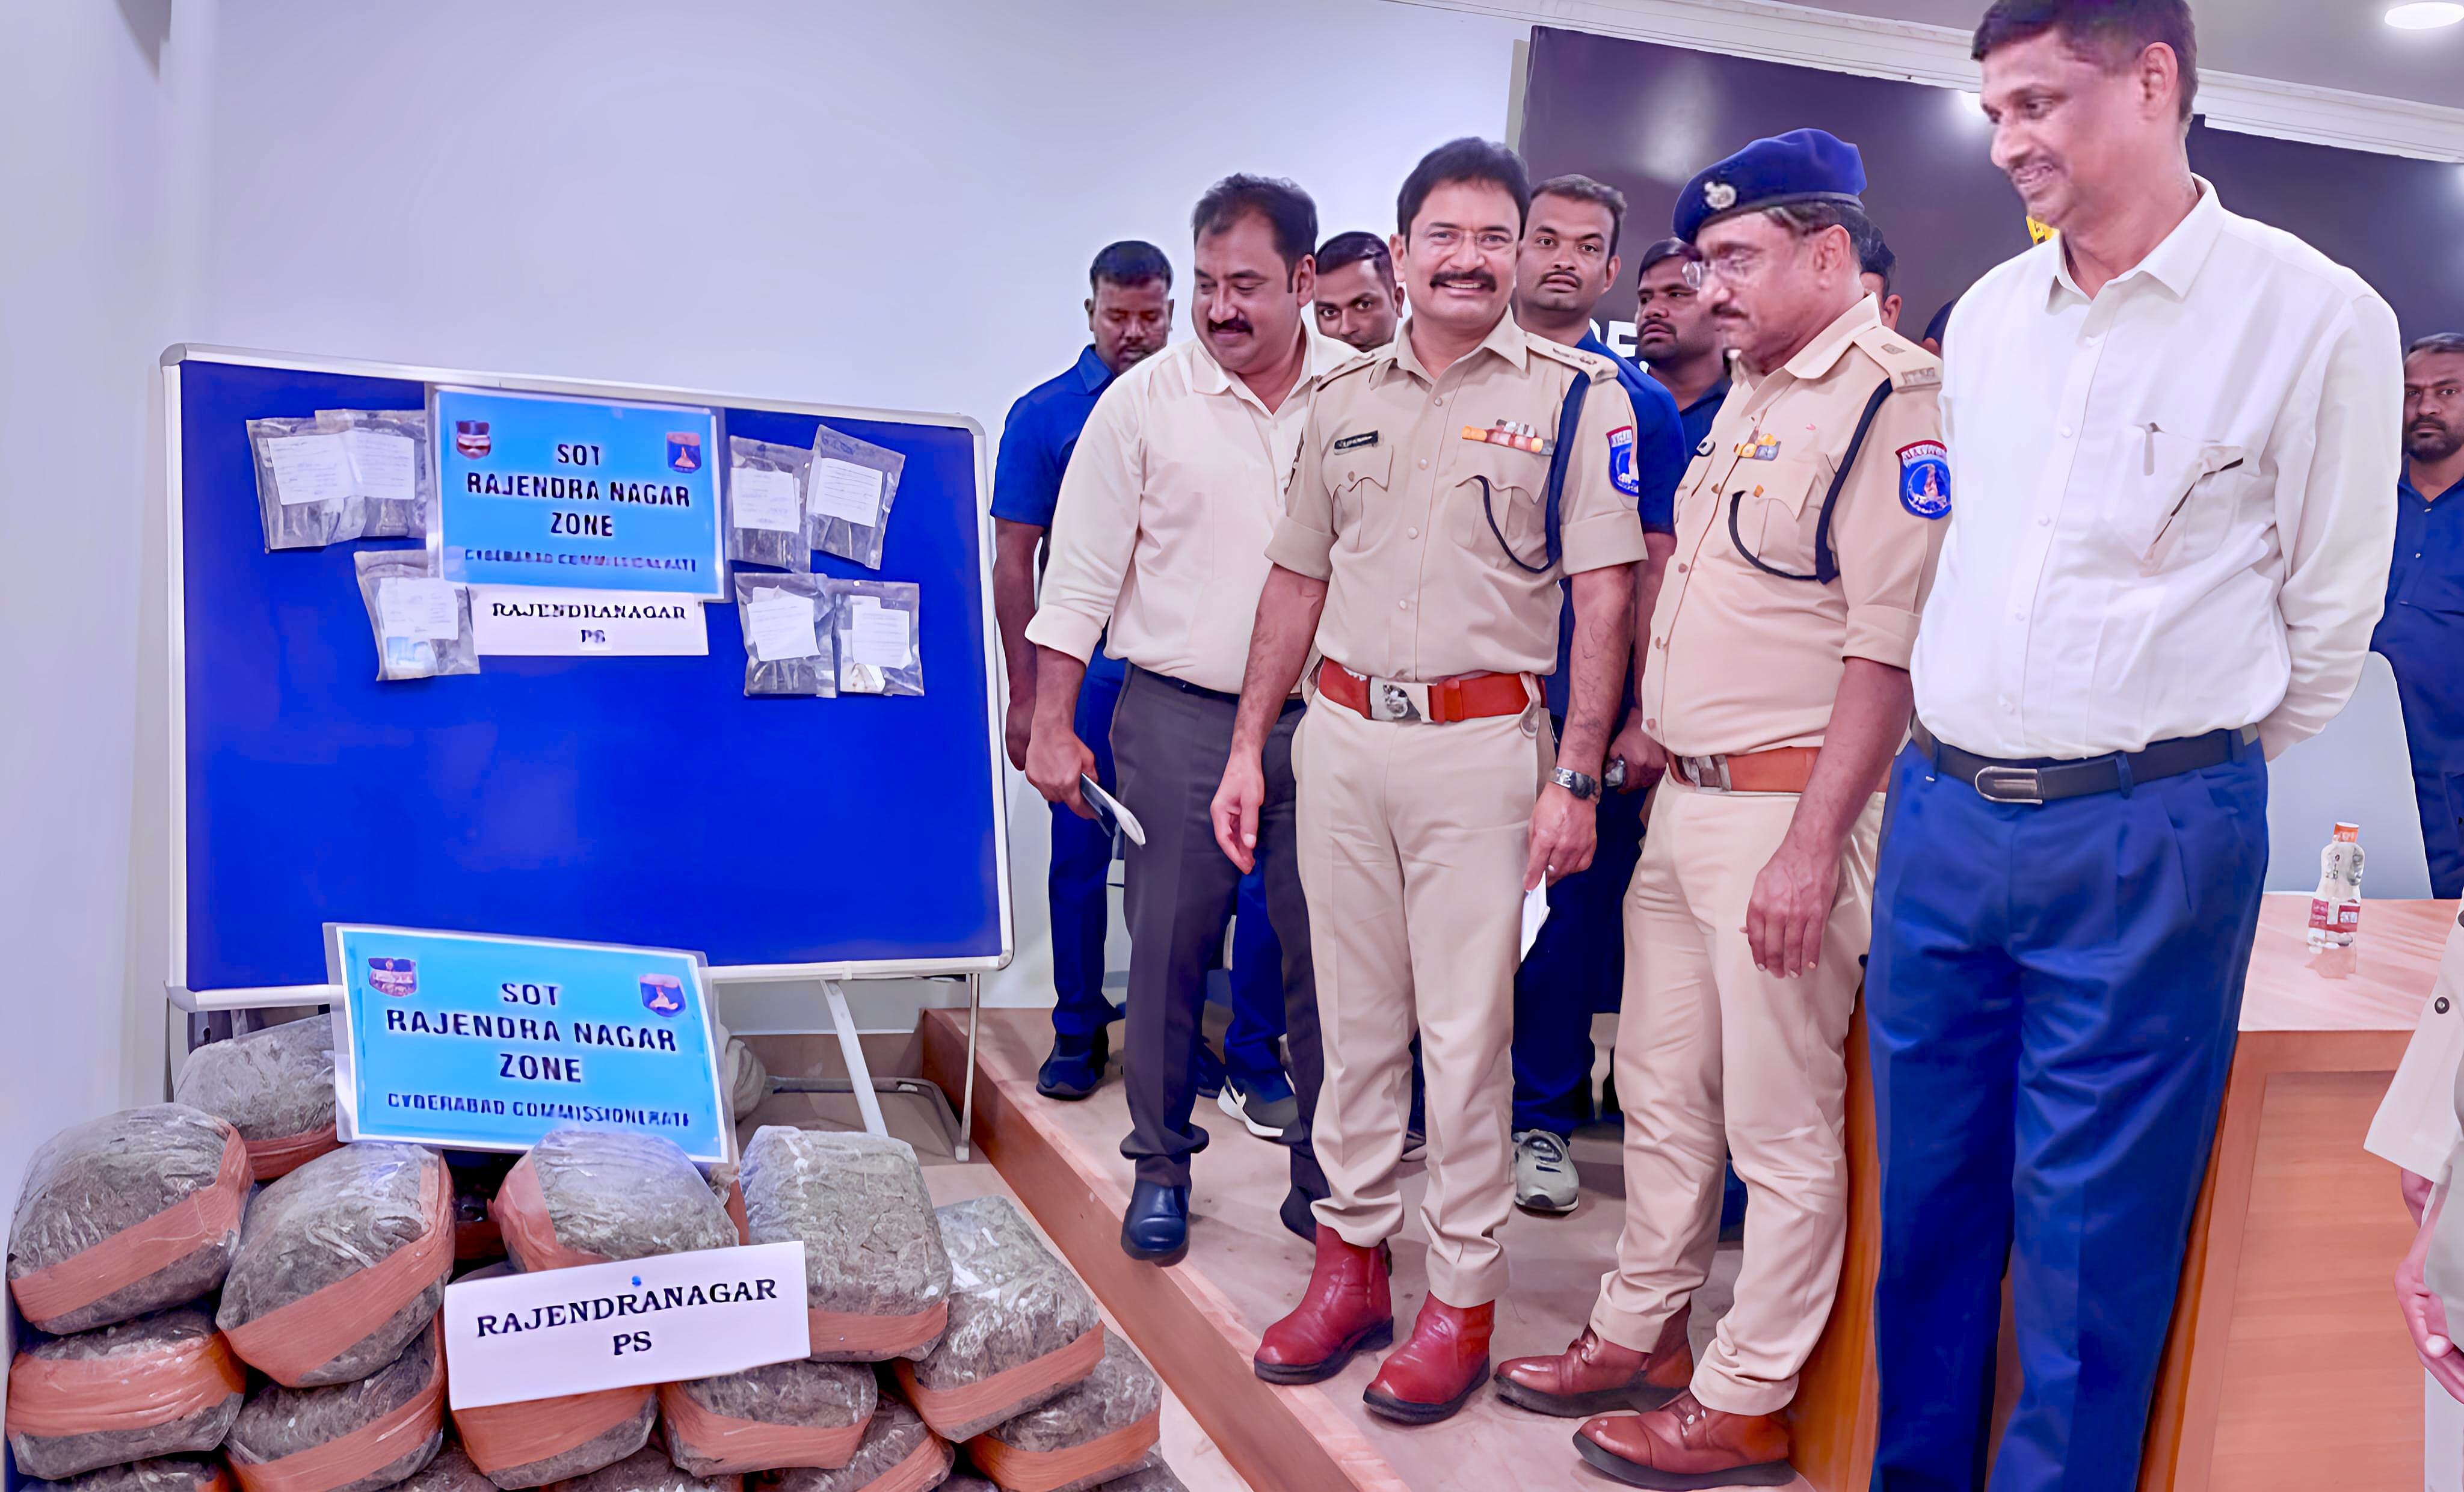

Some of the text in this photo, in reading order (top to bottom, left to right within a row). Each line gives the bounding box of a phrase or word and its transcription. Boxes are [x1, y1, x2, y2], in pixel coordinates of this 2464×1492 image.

[557, 444, 600, 466] SOT
[467, 472, 690, 507] RAJENDRA NAGAR
[550, 512, 613, 536] ZONE
[501, 983, 560, 1006] SOT
[386, 1009, 677, 1052] RAJENDRA NAGAR
[499, 1054, 582, 1083] ZONE
[476, 1279, 778, 1338] RAJENDRANAGAR
[612, 1330, 653, 1356] PS
